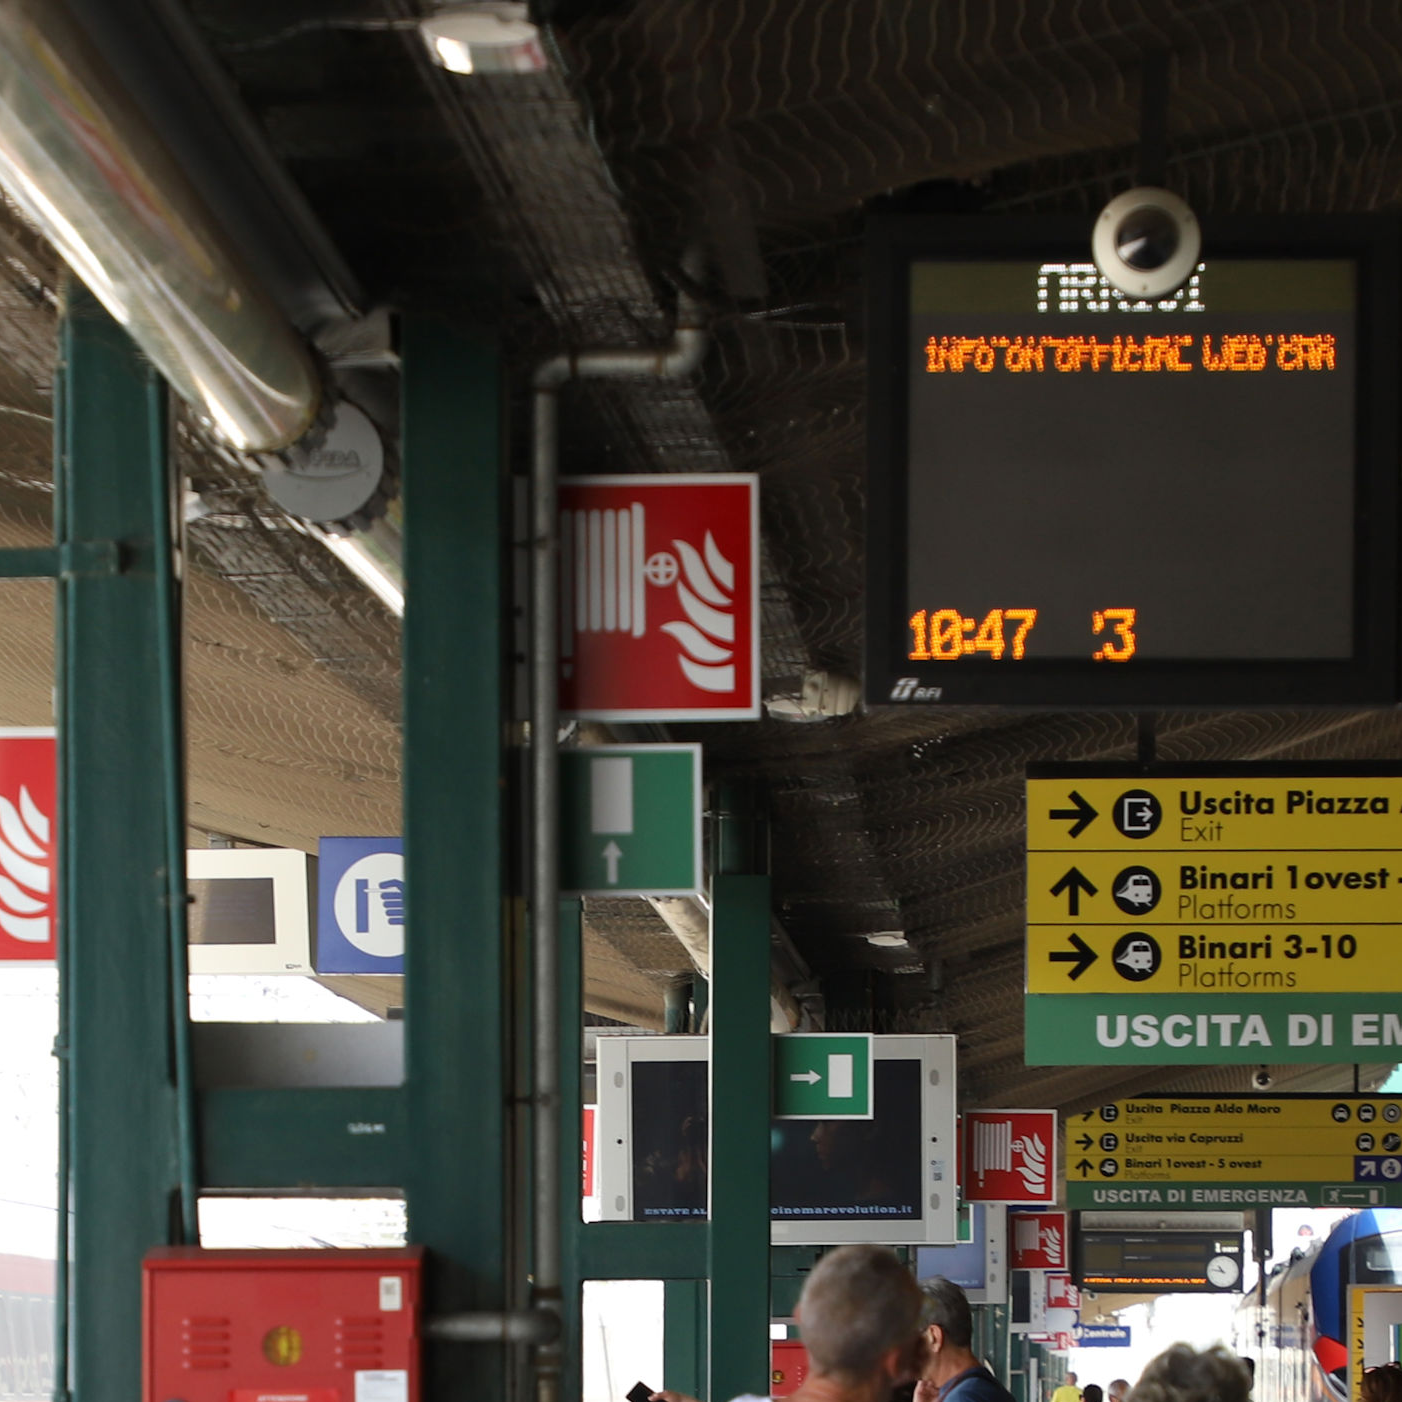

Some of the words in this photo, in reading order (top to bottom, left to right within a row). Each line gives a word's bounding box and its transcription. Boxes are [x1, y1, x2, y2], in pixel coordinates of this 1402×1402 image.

[908, 608, 1038, 660] 10:47
[1180, 789, 1275, 816] Uscita
[1286, 789, 1389, 816] Piazza
[1180, 819, 1224, 843] Exit
[1180, 864, 1274, 891] Binari
[1179, 893, 1297, 920] Platforms
[1179, 933, 1272, 959] Binari
[1285, 934, 1357, 959] 3-10
[1179, 963, 1297, 989] Platforms
[1096, 1015, 1271, 1048] USCITA
[1288, 1014, 1334, 1046] DI
[1125, 1103, 1163, 1114] Uscita
[1170, 1103, 1211, 1114] Piazza
[1214, 1103, 1243, 1114] Aldo
[1247, 1103, 1282, 1114] Moro
[1125, 1133, 1163, 1143] Uscita
[1166, 1133, 1186, 1143] via
[1189, 1133, 1244, 1145] Capruzzi
[1125, 1158, 1162, 1168] Binari
[1217, 1158, 1226, 1168] 5
[1229, 1158, 1262, 1168] ovest
[1093, 1189, 1163, 1203] USCITA
[1167, 1189, 1187, 1203] DI
[1191, 1188, 1308, 1203] EMERGENZA
